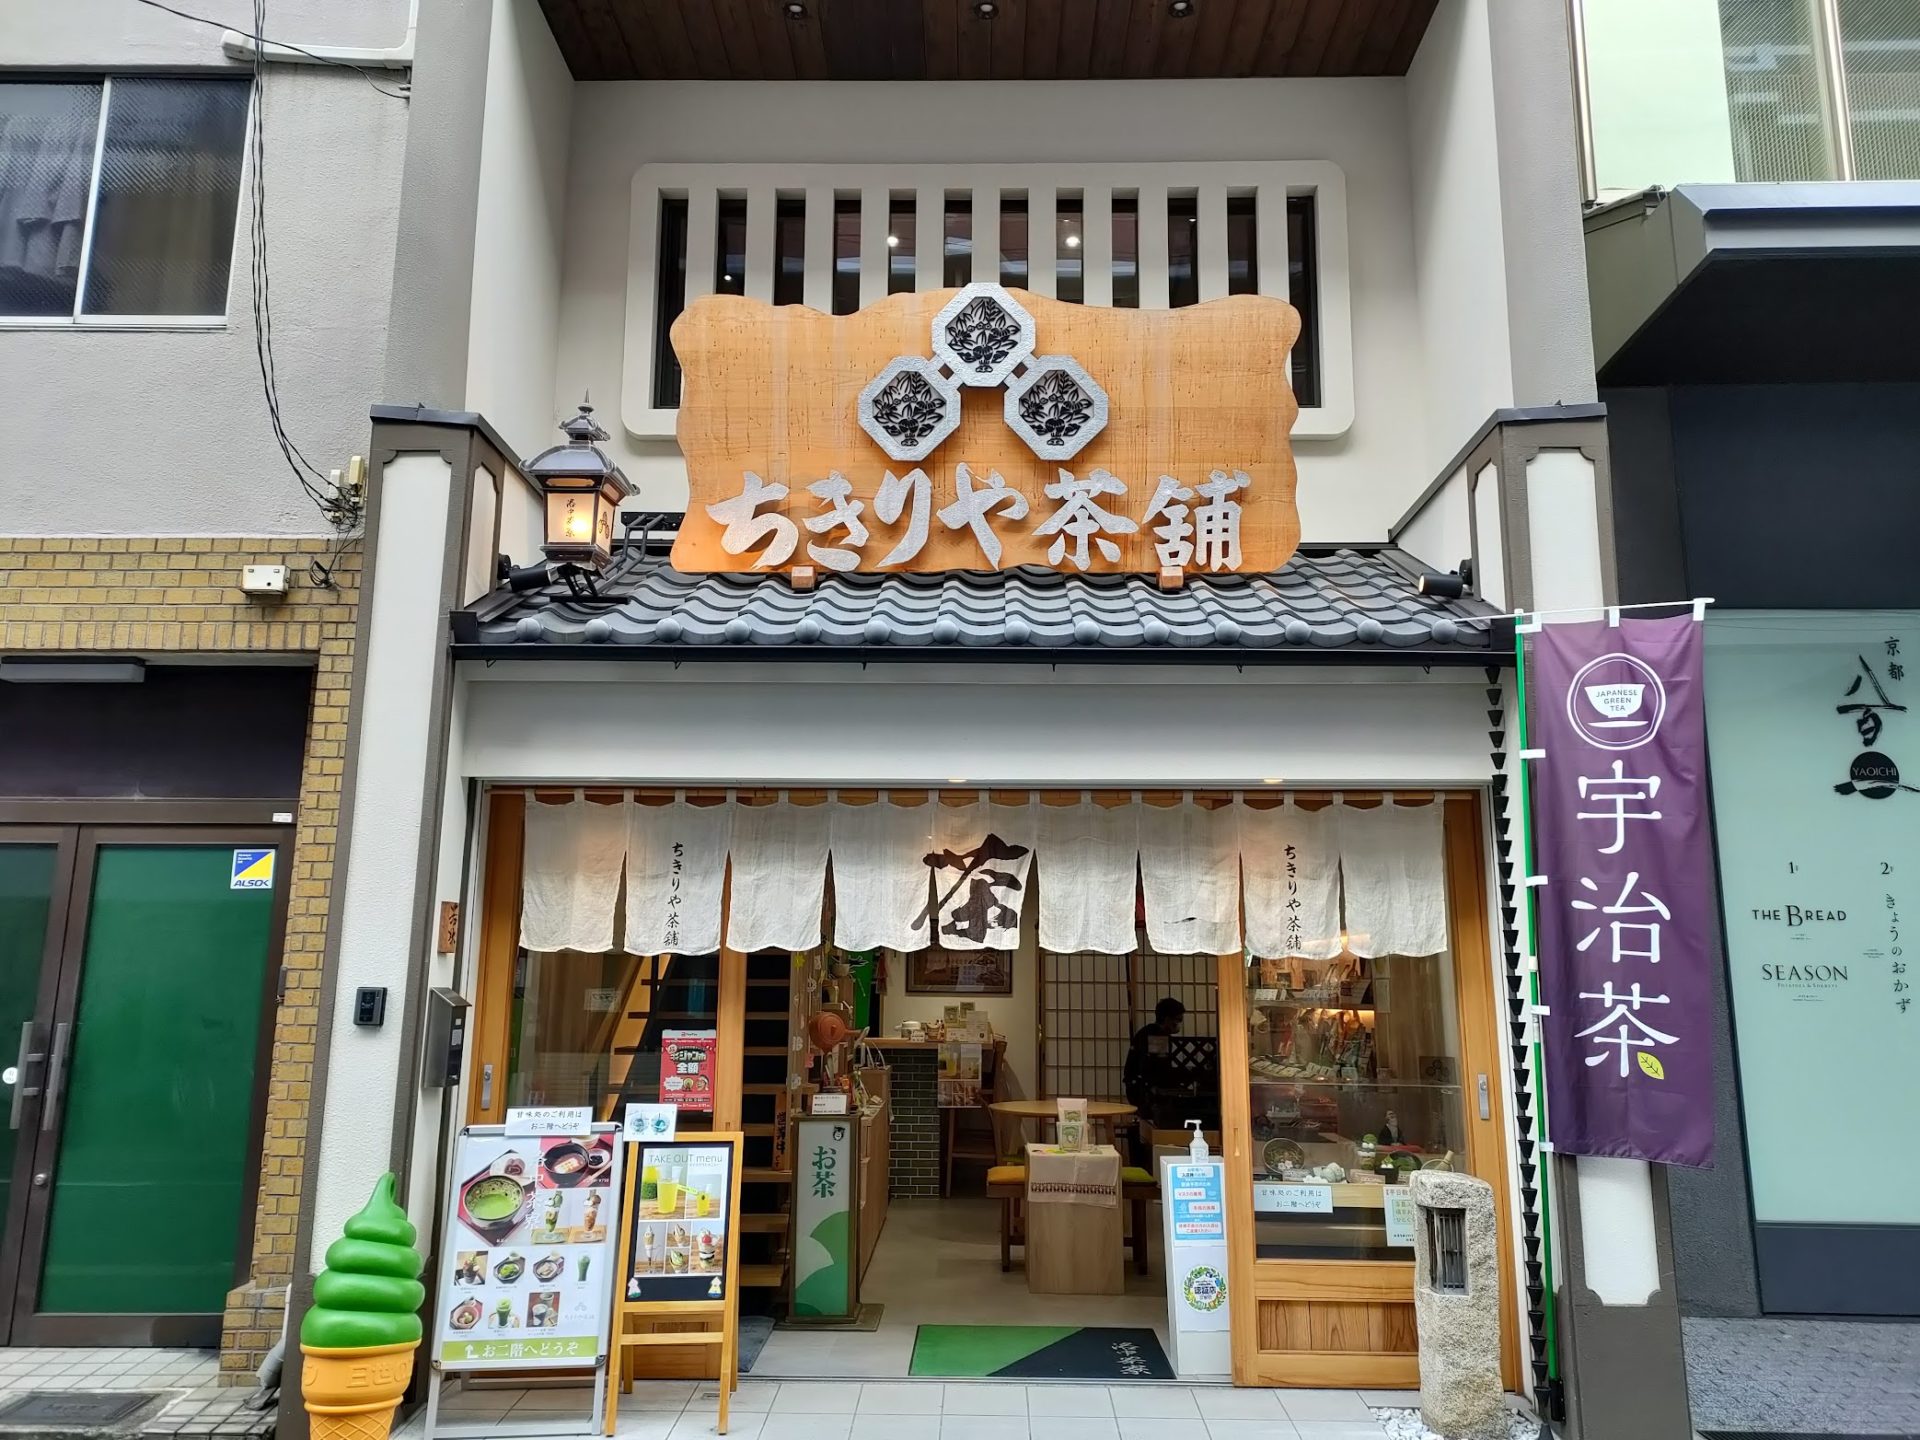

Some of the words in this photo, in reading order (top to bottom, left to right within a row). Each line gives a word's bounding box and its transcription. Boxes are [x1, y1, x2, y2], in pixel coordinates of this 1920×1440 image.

[705, 462, 1250, 572] ちきりや茶舗
[1884, 636, 1904, 681] 京都
[1595, 688, 1638, 698] JAPANESE
[1603, 697, 1632, 705] GREEN
[1609, 704, 1626, 712] TEA
[1851, 766, 1897, 778] YAOICHI
[663, 842, 683, 947] ちきりや茶舗
[911, 833, 1029, 943] 茶
[1283, 844, 1302, 950] ちきりや茶舗
[1571, 759, 1680, 1078] 宇治茶
[1752, 909, 1781, 921] THE
[1784, 905, 1847, 927] BREAD
[1885, 893, 1910, 1015] きょうのおかず
[1762, 962, 1848, 981] SEASON
[676, 1062, 699, 1074] 全額
[531, 1122, 580, 1130] お二階へどうぞ
[649, 1155, 671, 1163] TAKE
[673, 1154, 695, 1163] OUT
[696, 1155, 722, 1163] menu
[812, 1145, 836, 1198] お茶
[482, 1341, 580, 1358] お二階へどうぞ
